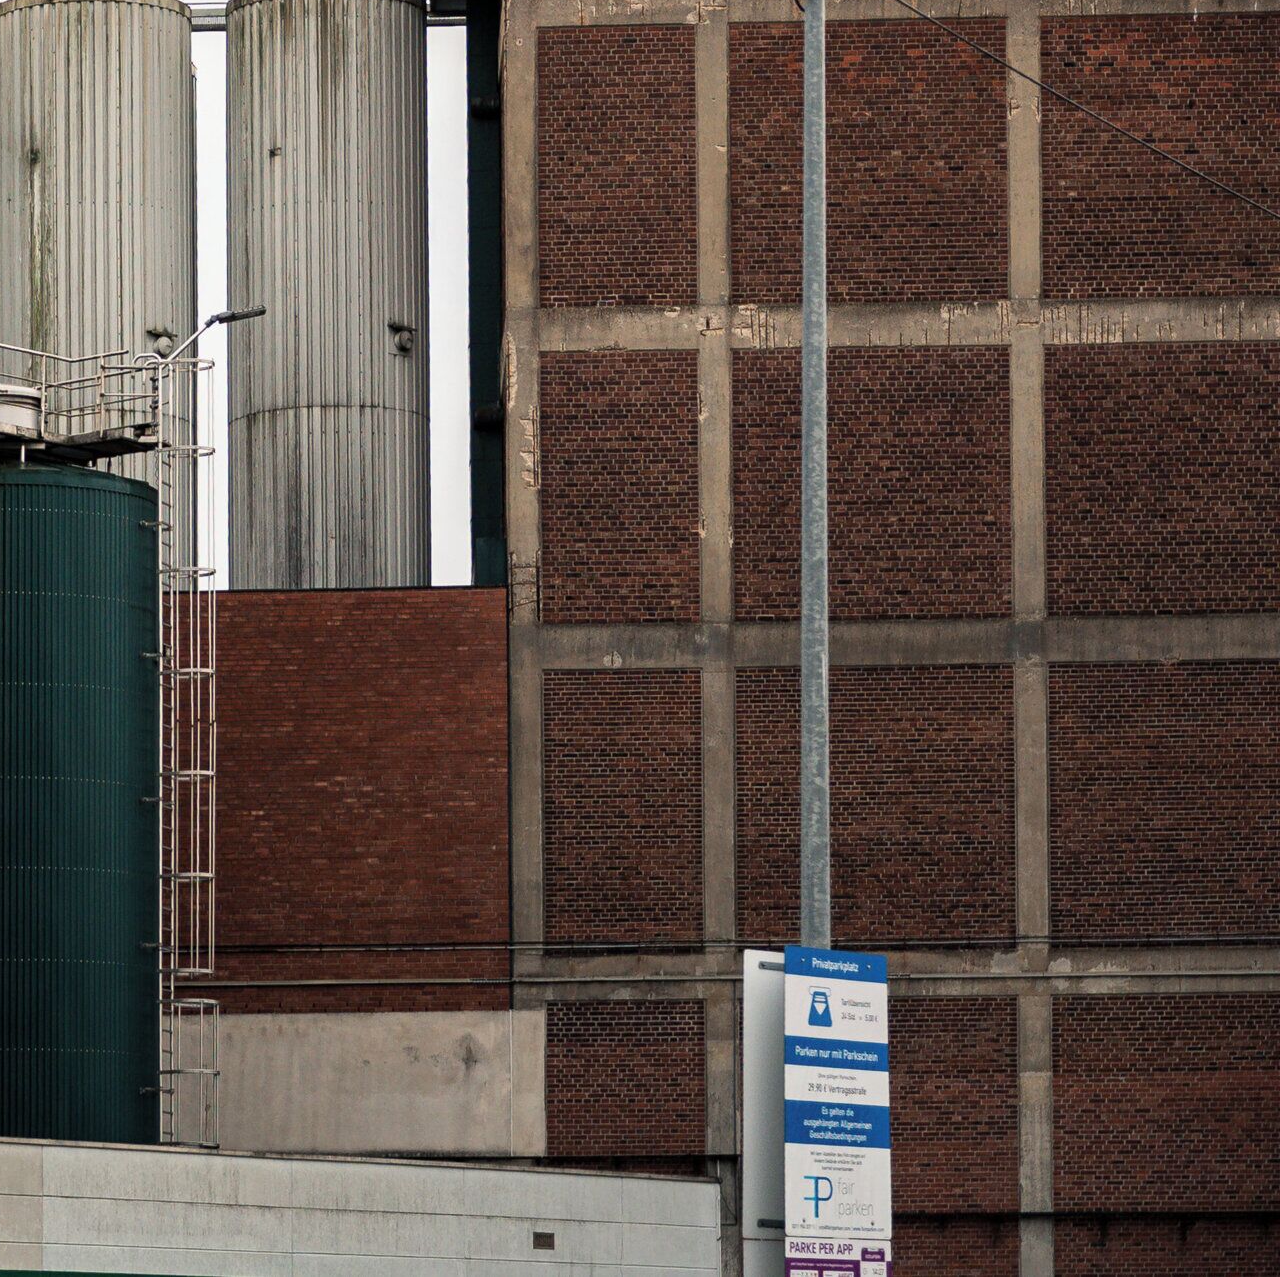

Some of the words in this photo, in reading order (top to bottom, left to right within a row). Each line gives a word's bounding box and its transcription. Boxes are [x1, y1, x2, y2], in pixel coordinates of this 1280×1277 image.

[812, 958, 859, 972] Privatparkplatz
[795, 1045, 818, 1057] Parken
[819, 1049, 830, 1058] nur
[832, 1049, 842, 1059] mit
[844, 1049, 878, 1062] Parkschein
[828, 1085, 866, 1096] Vertragsstrafe
[821, 1106, 828, 1115] Es
[829, 1108, 845, 1117] gelten
[846, 1108, 854, 1116] die
[841, 1120, 872, 1130] Allgemeinen
[837, 1177, 856, 1196] fair
[839, 1199, 874, 1219] parken
[790, 1242, 817, 1254] PARKE
[819, 1243, 834, 1255] PER
[837, 1244, 853, 1255] APP
